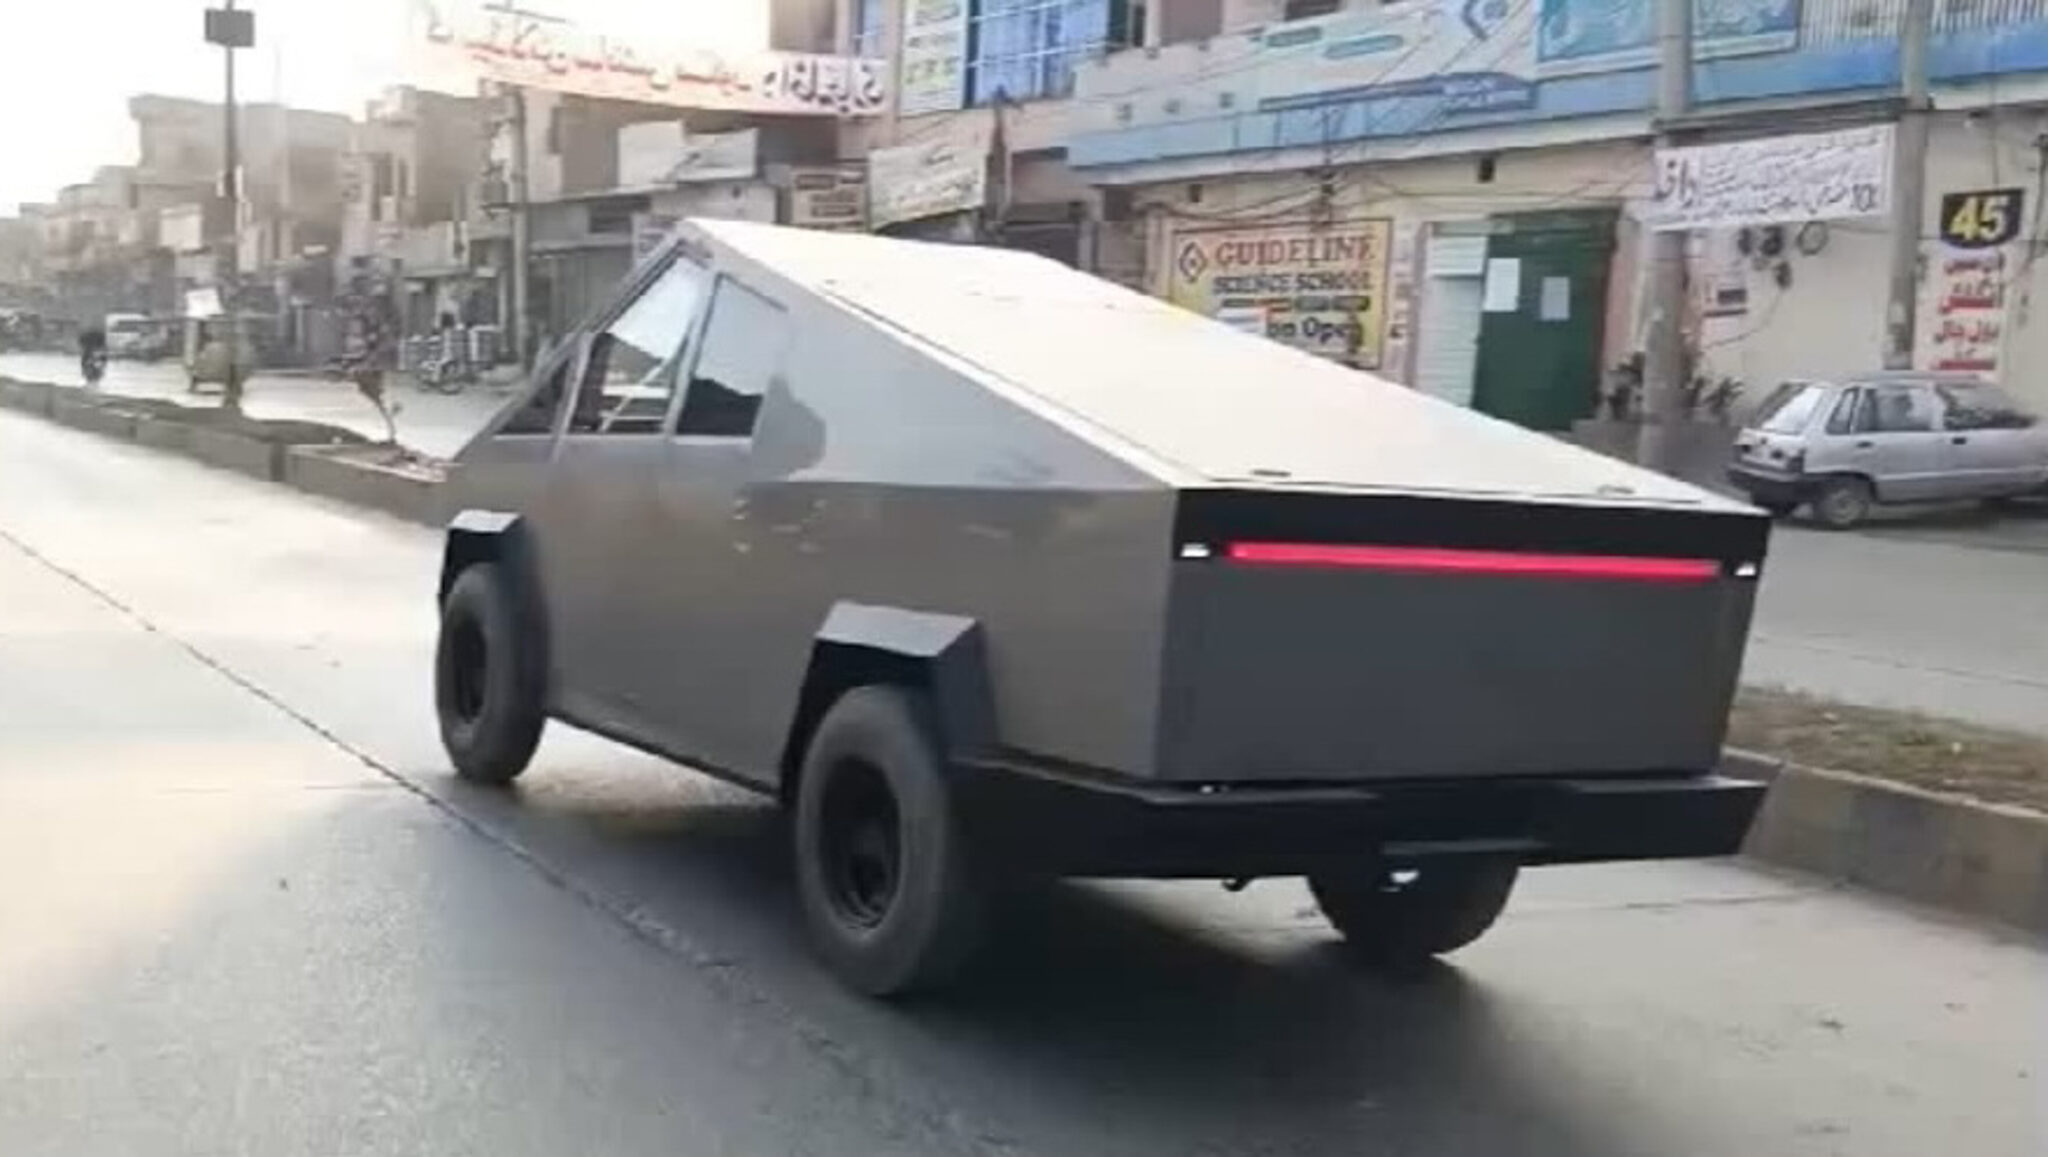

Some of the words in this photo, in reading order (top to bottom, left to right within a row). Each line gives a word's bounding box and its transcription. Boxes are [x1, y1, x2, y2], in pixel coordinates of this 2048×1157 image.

[1950, 196, 2010, 240] 45
[1215, 236, 1375, 266] GUIDELINE
[1213, 274, 1291, 294] SCIENCE
[1295, 270, 1374, 291] SCHOOL
